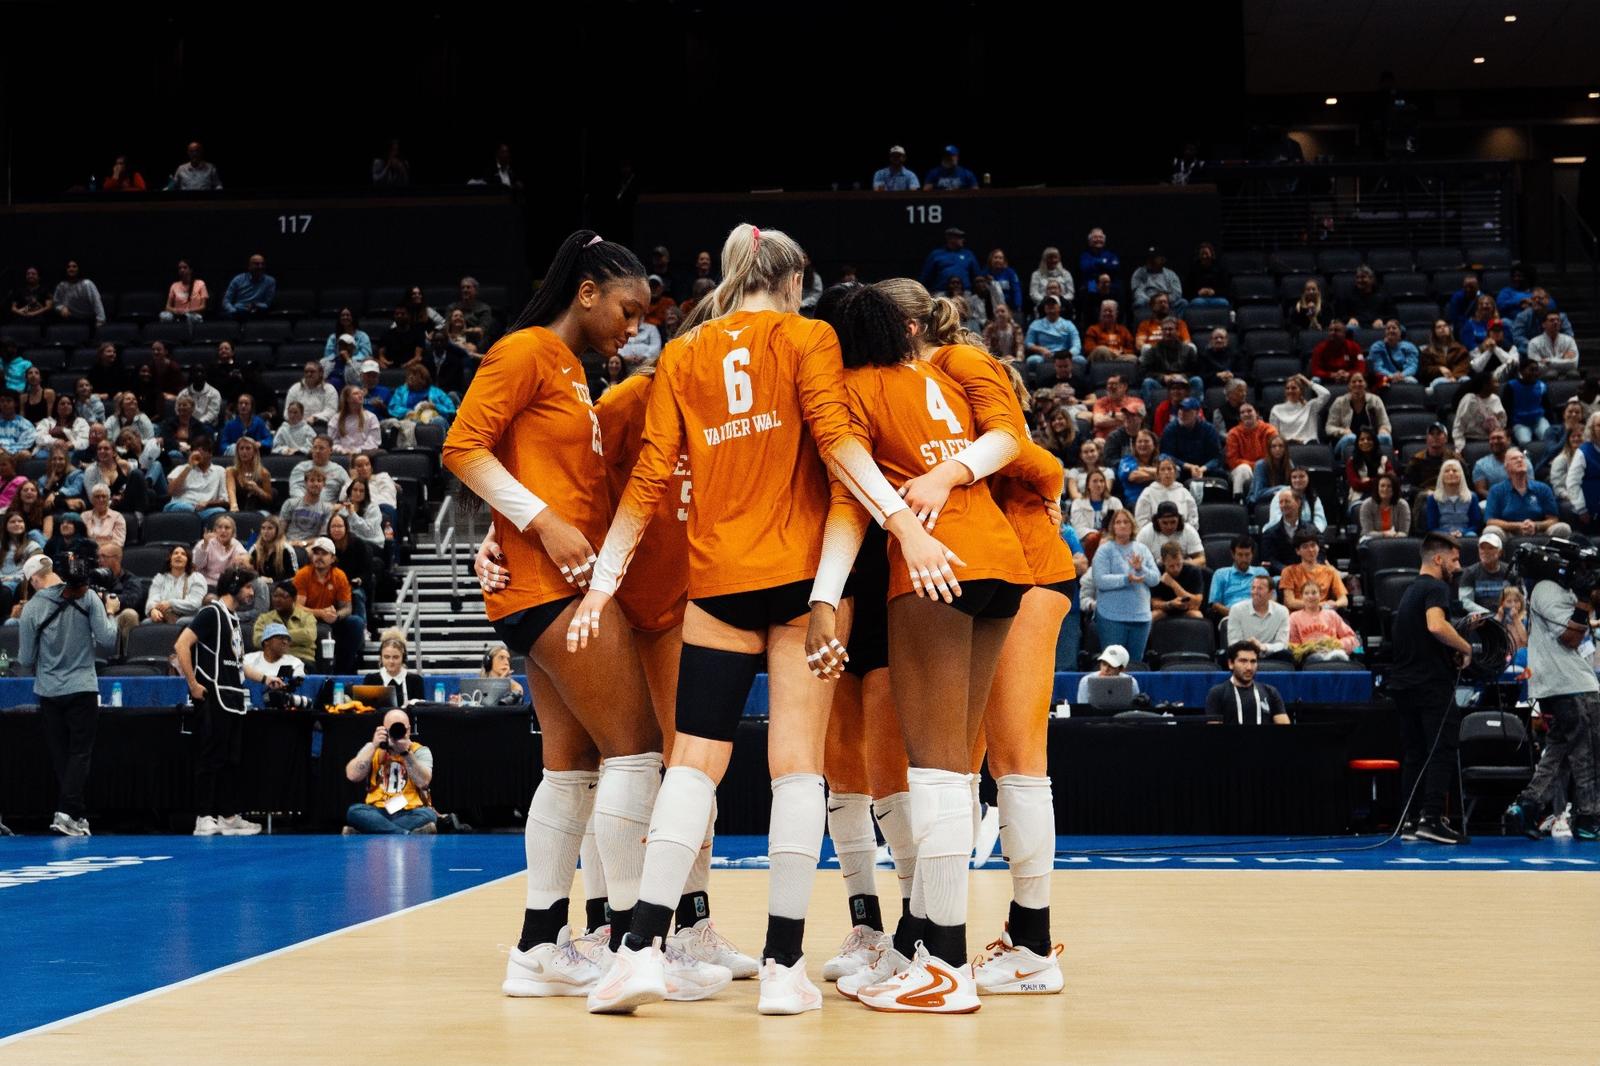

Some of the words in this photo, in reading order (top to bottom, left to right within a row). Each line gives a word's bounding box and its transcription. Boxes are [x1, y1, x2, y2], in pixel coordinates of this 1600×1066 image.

[278, 215, 312, 233] 117
[906, 205, 942, 223] 118
[722, 347, 753, 415] 6
[925, 376, 964, 434] 4
[752, 410, 782, 433] WAL
